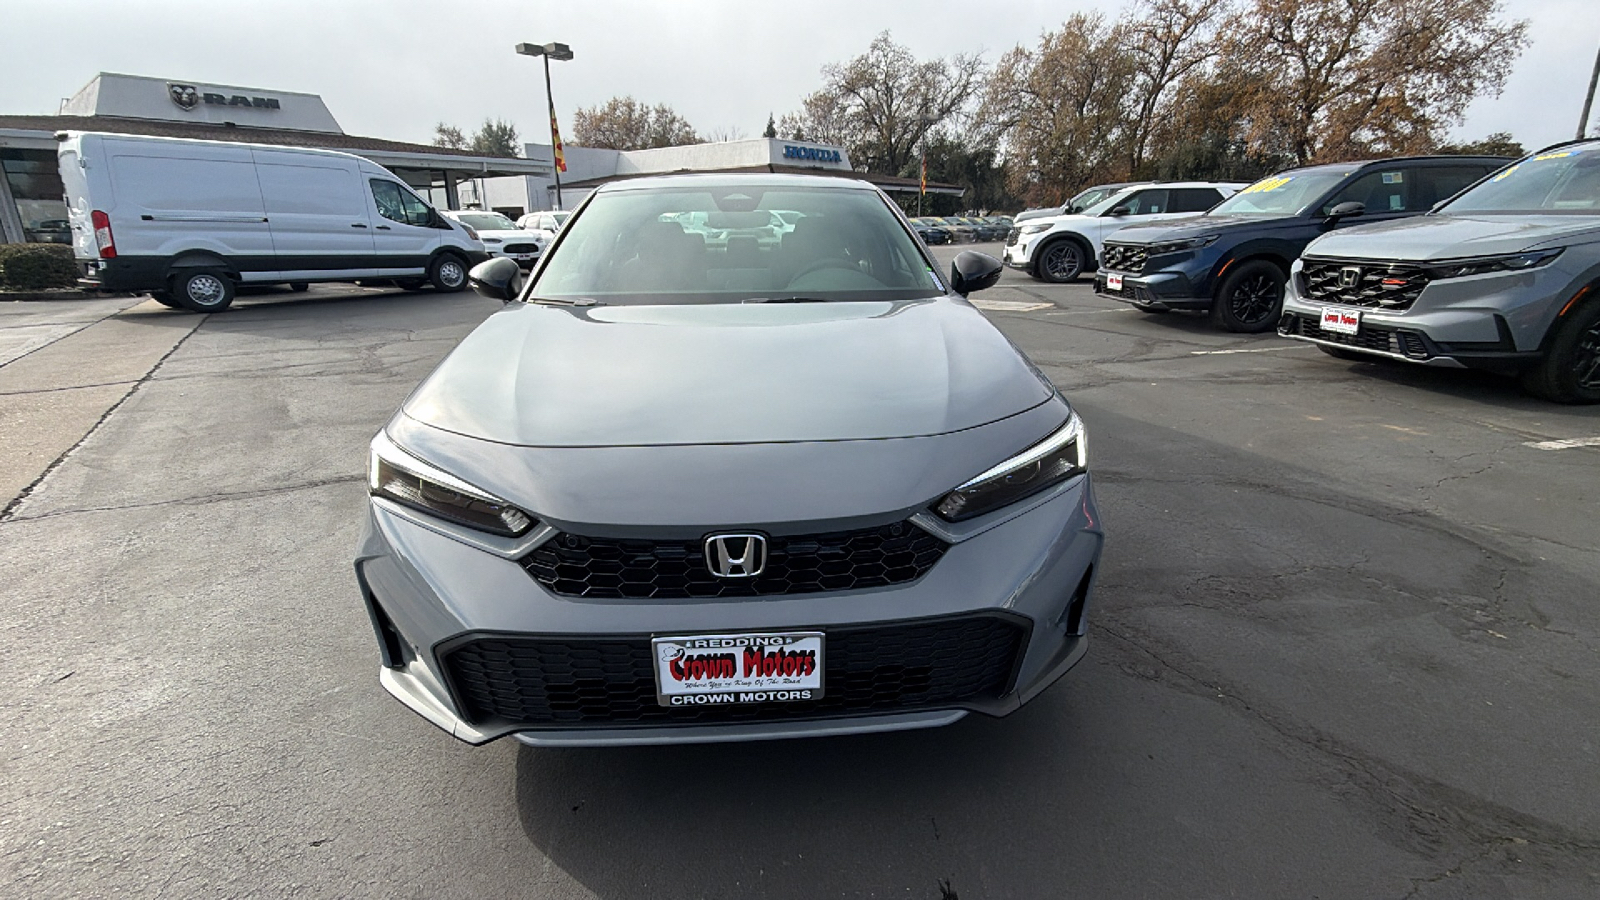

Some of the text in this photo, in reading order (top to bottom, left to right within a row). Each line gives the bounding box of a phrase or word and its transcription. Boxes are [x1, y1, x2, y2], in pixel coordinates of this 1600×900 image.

[203, 92, 280, 110] RAM
[783, 145, 842, 162] HONDA
[694, 637, 783, 648] REDDING
[669, 646, 816, 682] Crown Motors
[754, 679, 764, 687] Of
[671, 690, 812, 705] CROWN MOTORS
